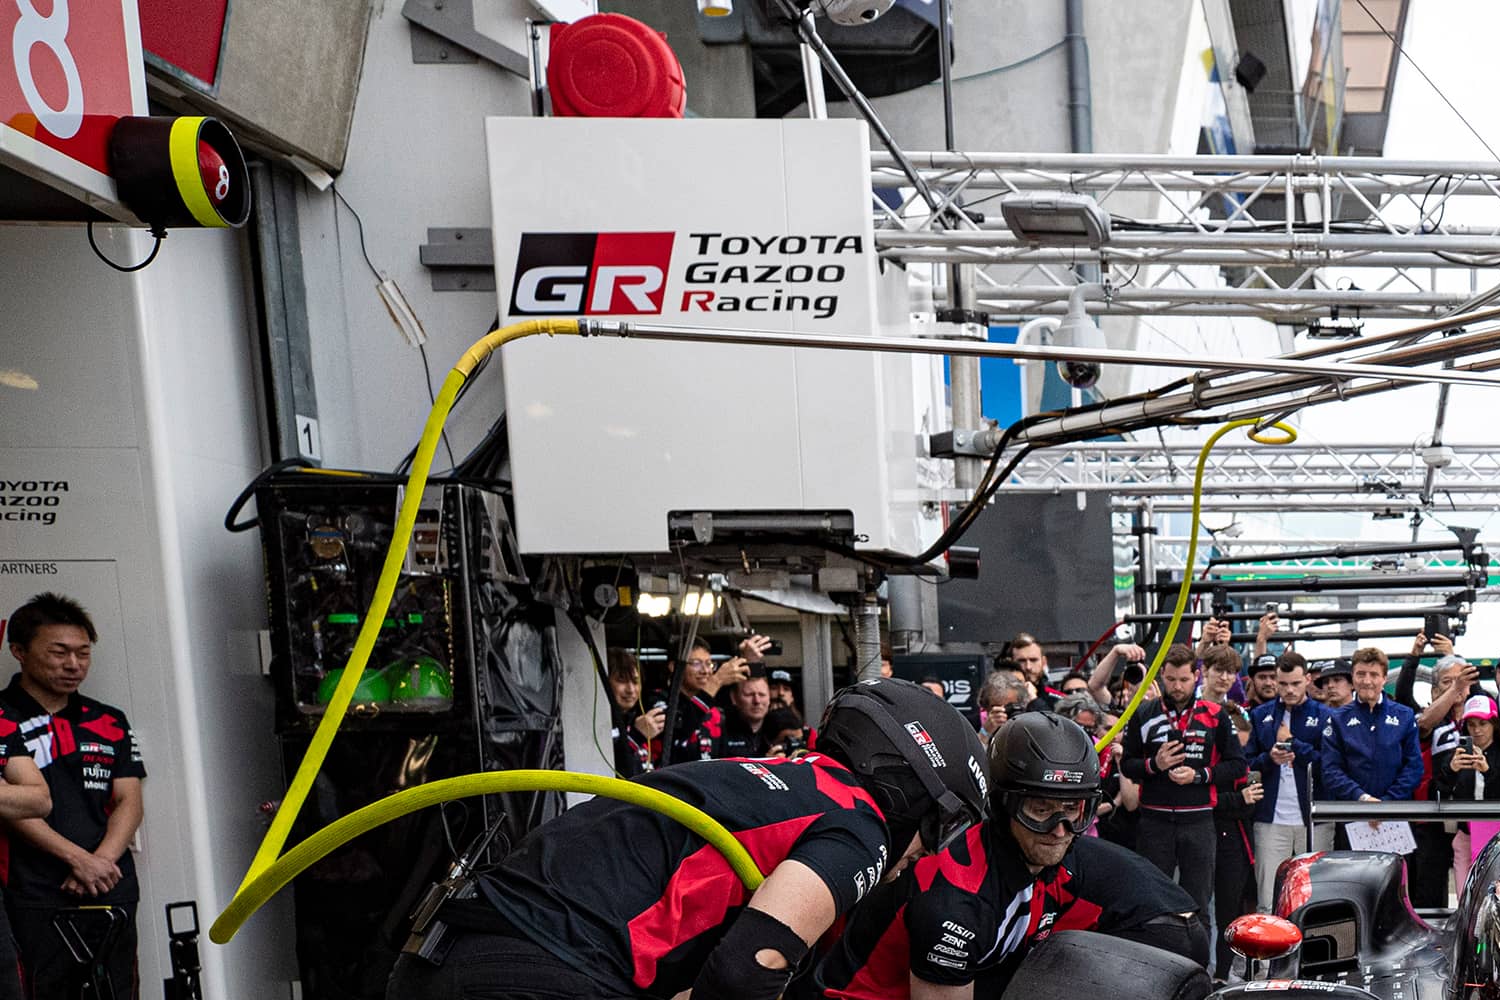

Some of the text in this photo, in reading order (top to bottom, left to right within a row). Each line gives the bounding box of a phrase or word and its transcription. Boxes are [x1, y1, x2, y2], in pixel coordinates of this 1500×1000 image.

[215, 164, 230, 200] 8
[689, 232, 864, 256] TOYOTA
[684, 262, 846, 284] GAZOO
[514, 266, 665, 313] GR
[680, 289, 839, 319] Racing
[303, 422, 313, 455] 1
[0, 508, 57, 525] cing
[941, 933, 967, 949] ZENT
[942, 920, 976, 940] AISIN
